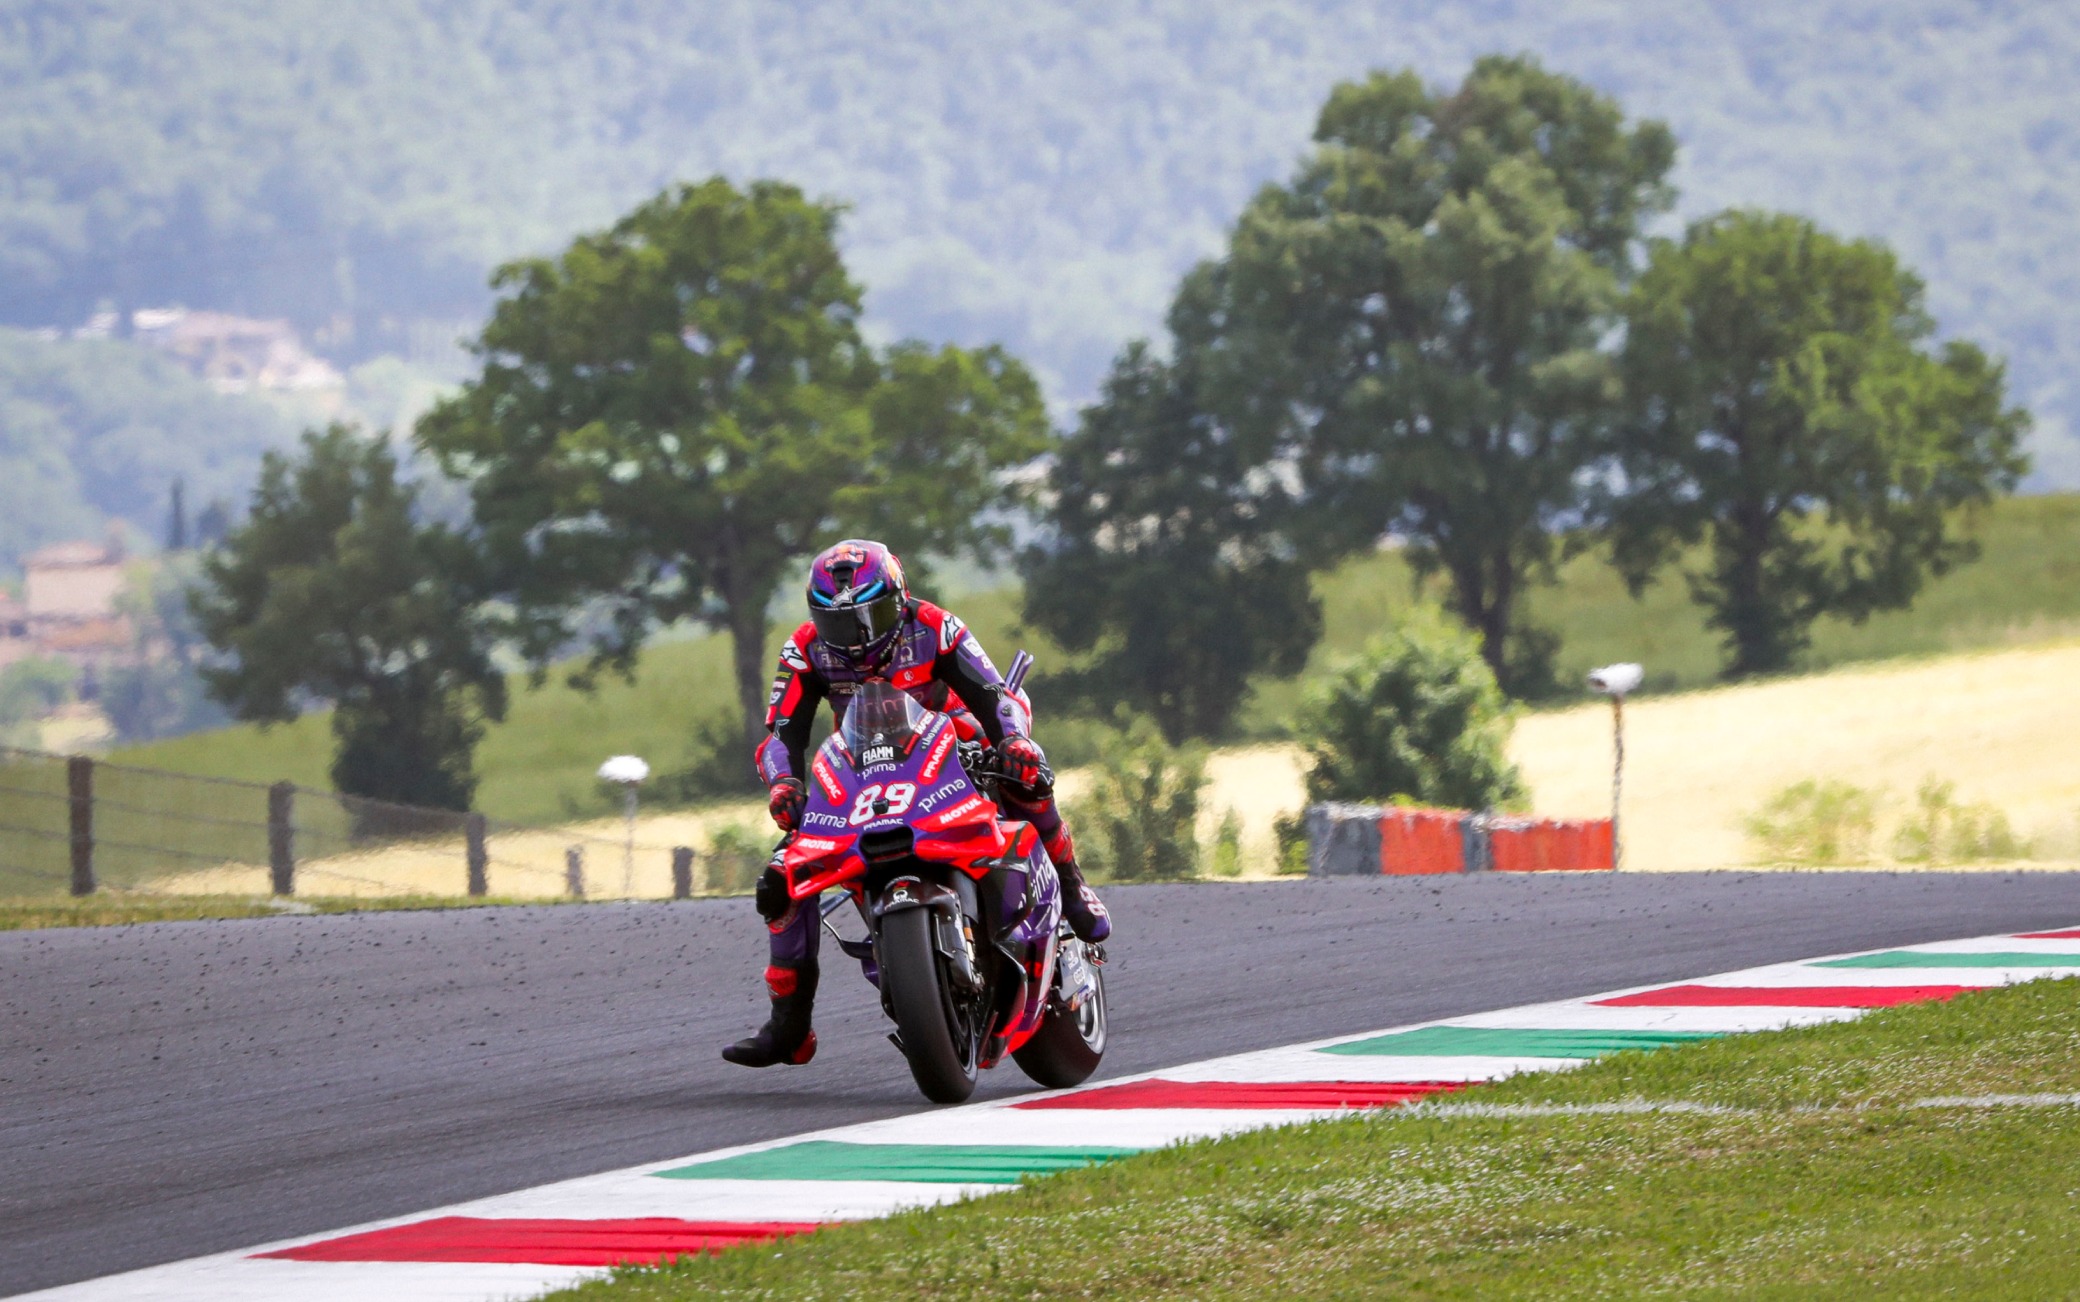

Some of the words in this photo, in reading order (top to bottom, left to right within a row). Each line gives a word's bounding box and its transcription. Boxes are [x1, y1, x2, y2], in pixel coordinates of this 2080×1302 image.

[862, 746, 894, 766] FIAMM
[923, 733, 954, 778] PRAMAC
[814, 761, 842, 799] PRAMAC
[862, 763, 897, 780] prima
[848, 783, 917, 826] 89
[918, 778, 967, 813] prima
[803, 811, 847, 829] prima
[939, 798, 982, 824] MOTUL
[863, 818, 904, 831] PRAMAC
[797, 837, 836, 851] MOTUL
